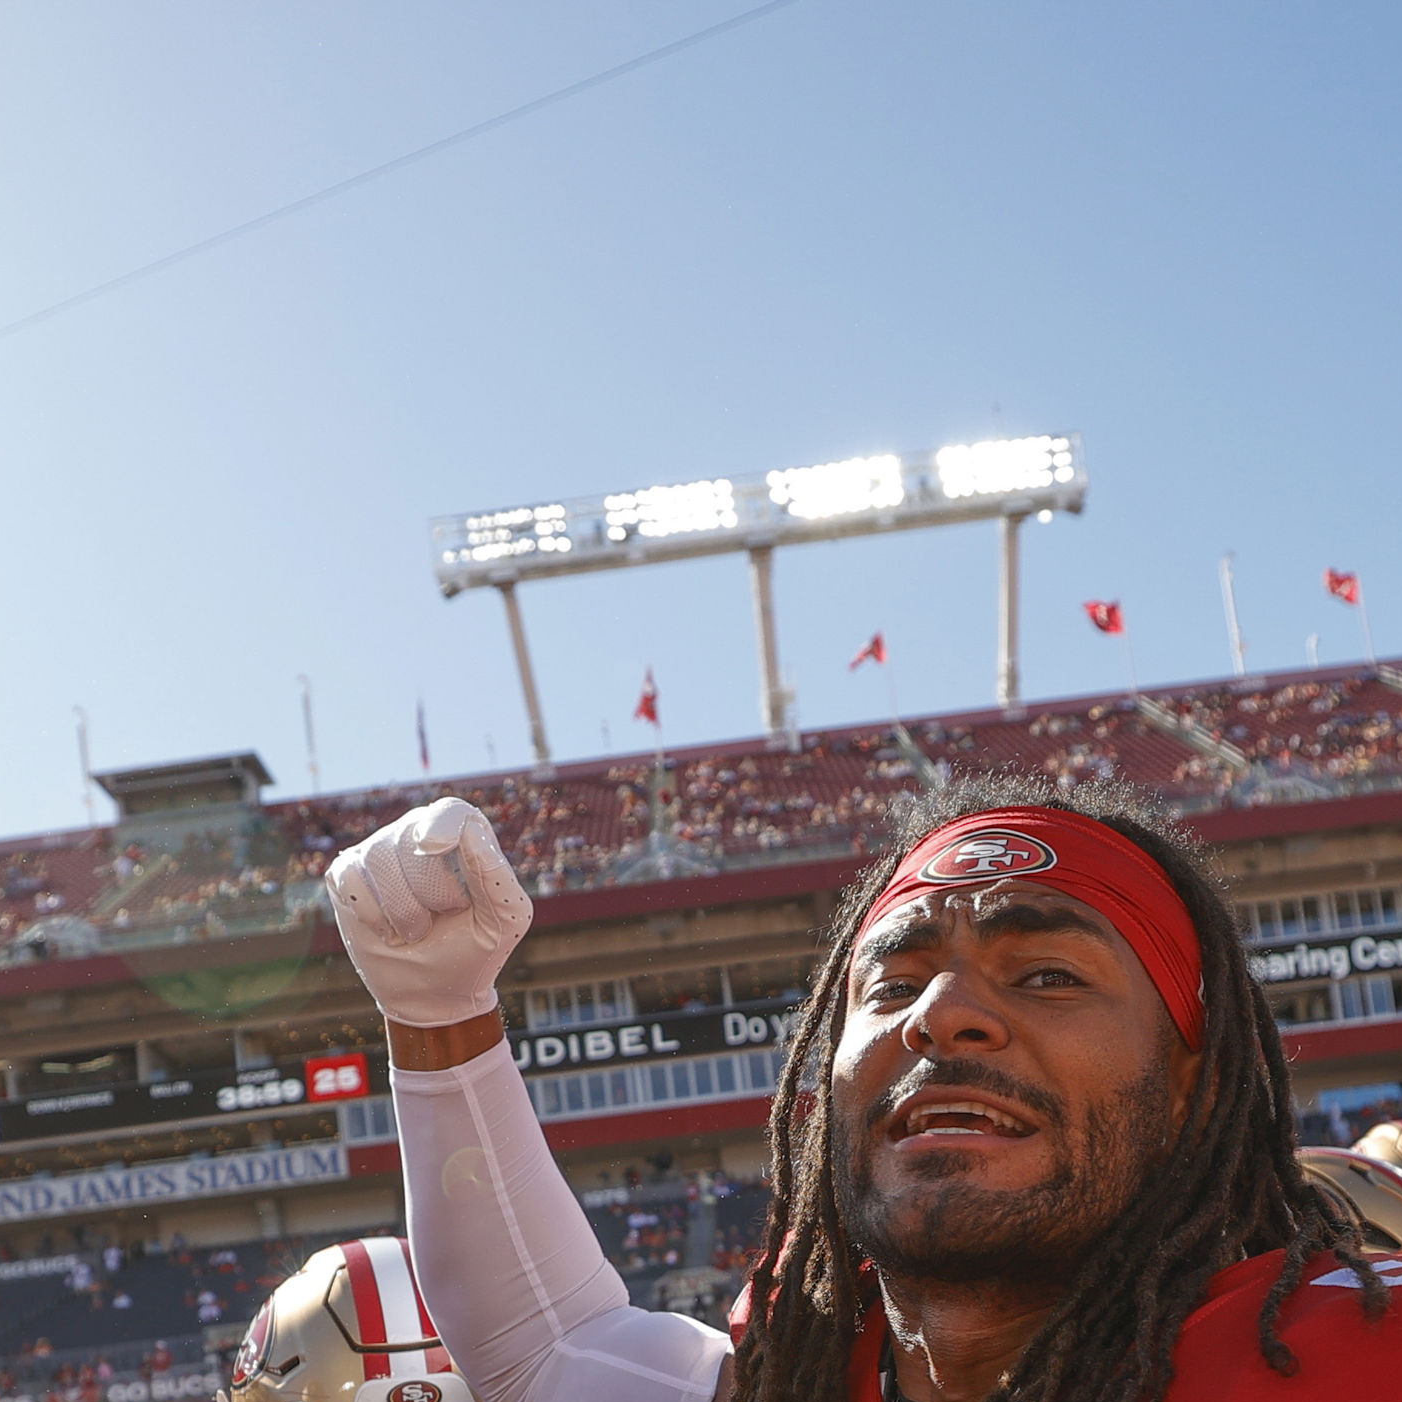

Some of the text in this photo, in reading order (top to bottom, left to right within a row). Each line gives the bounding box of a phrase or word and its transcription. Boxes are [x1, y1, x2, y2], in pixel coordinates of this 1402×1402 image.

[1249, 943, 1351, 982] aring
[313, 1065, 363, 1095] 25
[55, 1167, 176, 1211] JAMES
[184, 1147, 340, 1189] STADIUM
